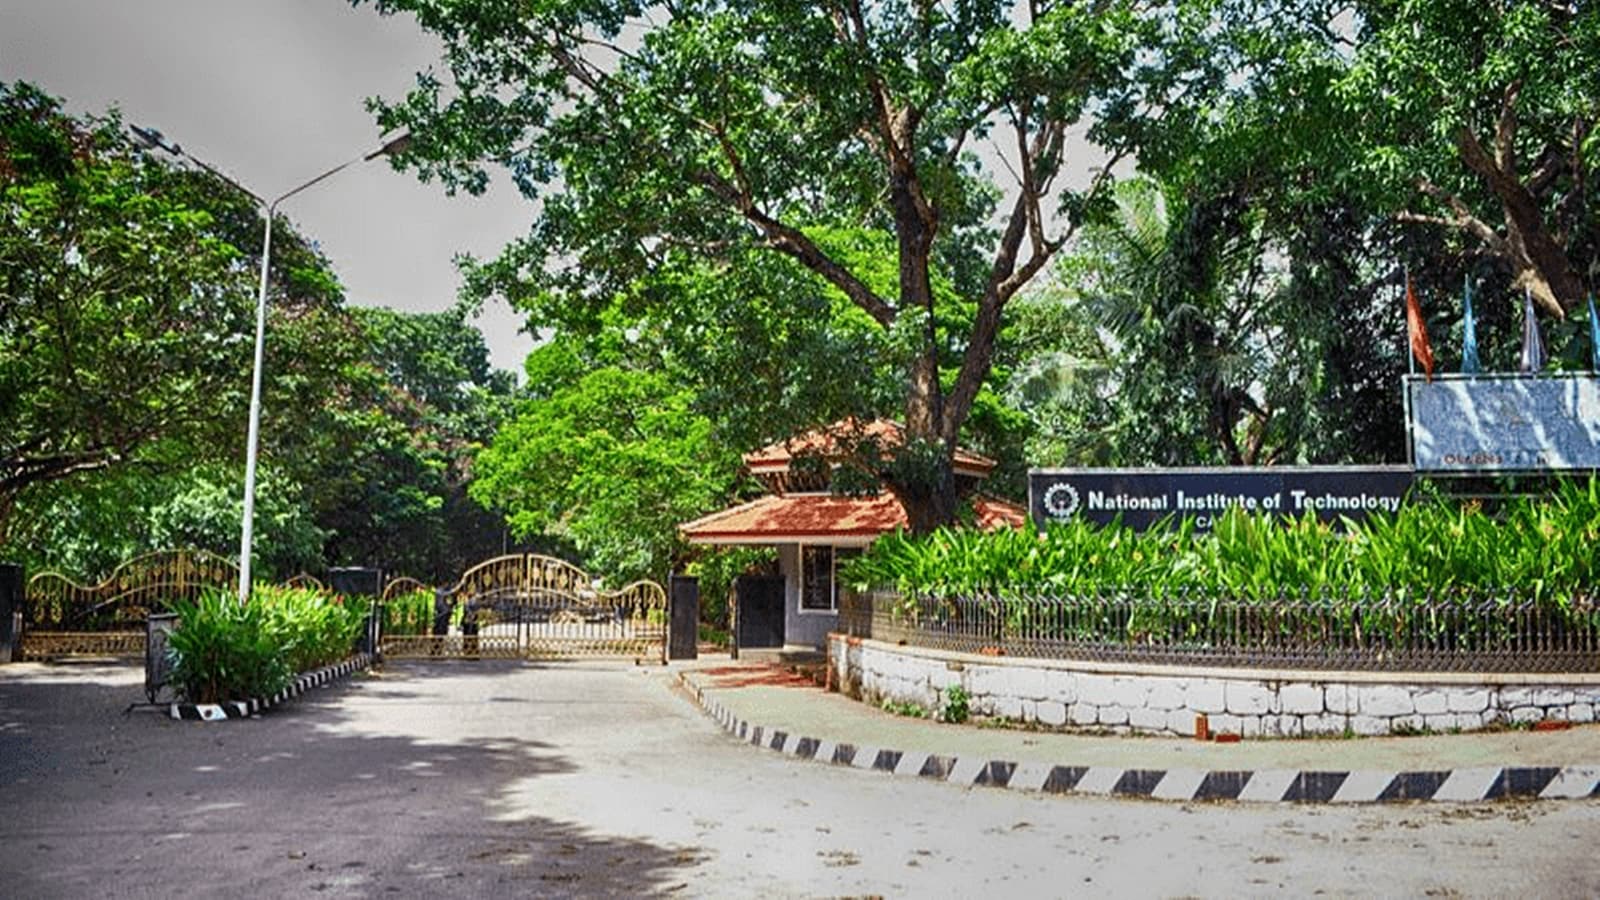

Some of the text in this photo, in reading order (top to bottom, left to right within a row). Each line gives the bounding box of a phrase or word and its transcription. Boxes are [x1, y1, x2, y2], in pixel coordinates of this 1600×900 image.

[1088, 489, 1401, 512] National Institute of Technology
